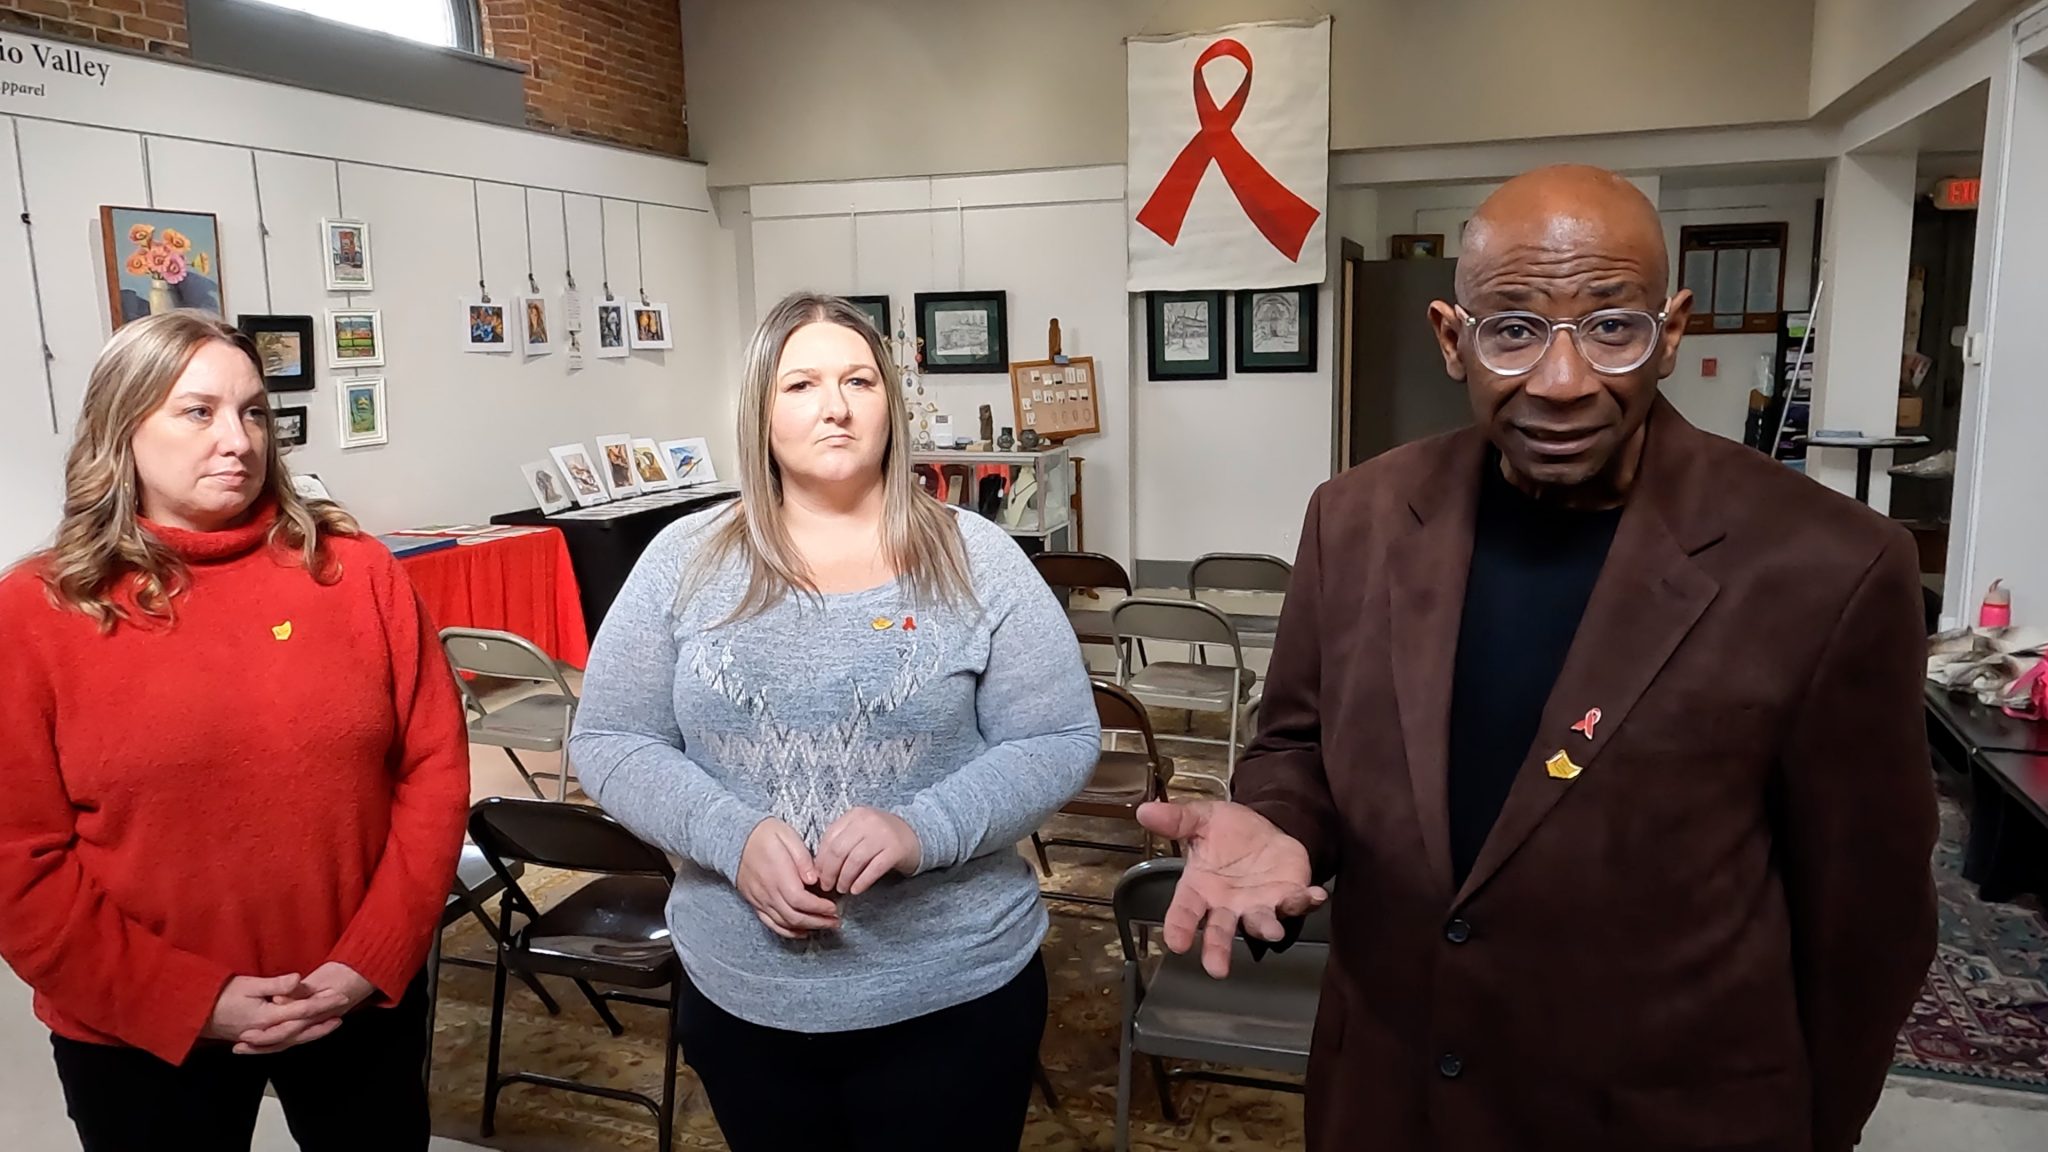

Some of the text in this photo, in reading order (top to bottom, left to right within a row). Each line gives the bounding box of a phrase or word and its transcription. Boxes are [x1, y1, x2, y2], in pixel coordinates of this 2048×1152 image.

[0, 37, 110, 86] io Valley
[0, 81, 45, 97] pparel
[1951, 181, 1978, 204] EXI
